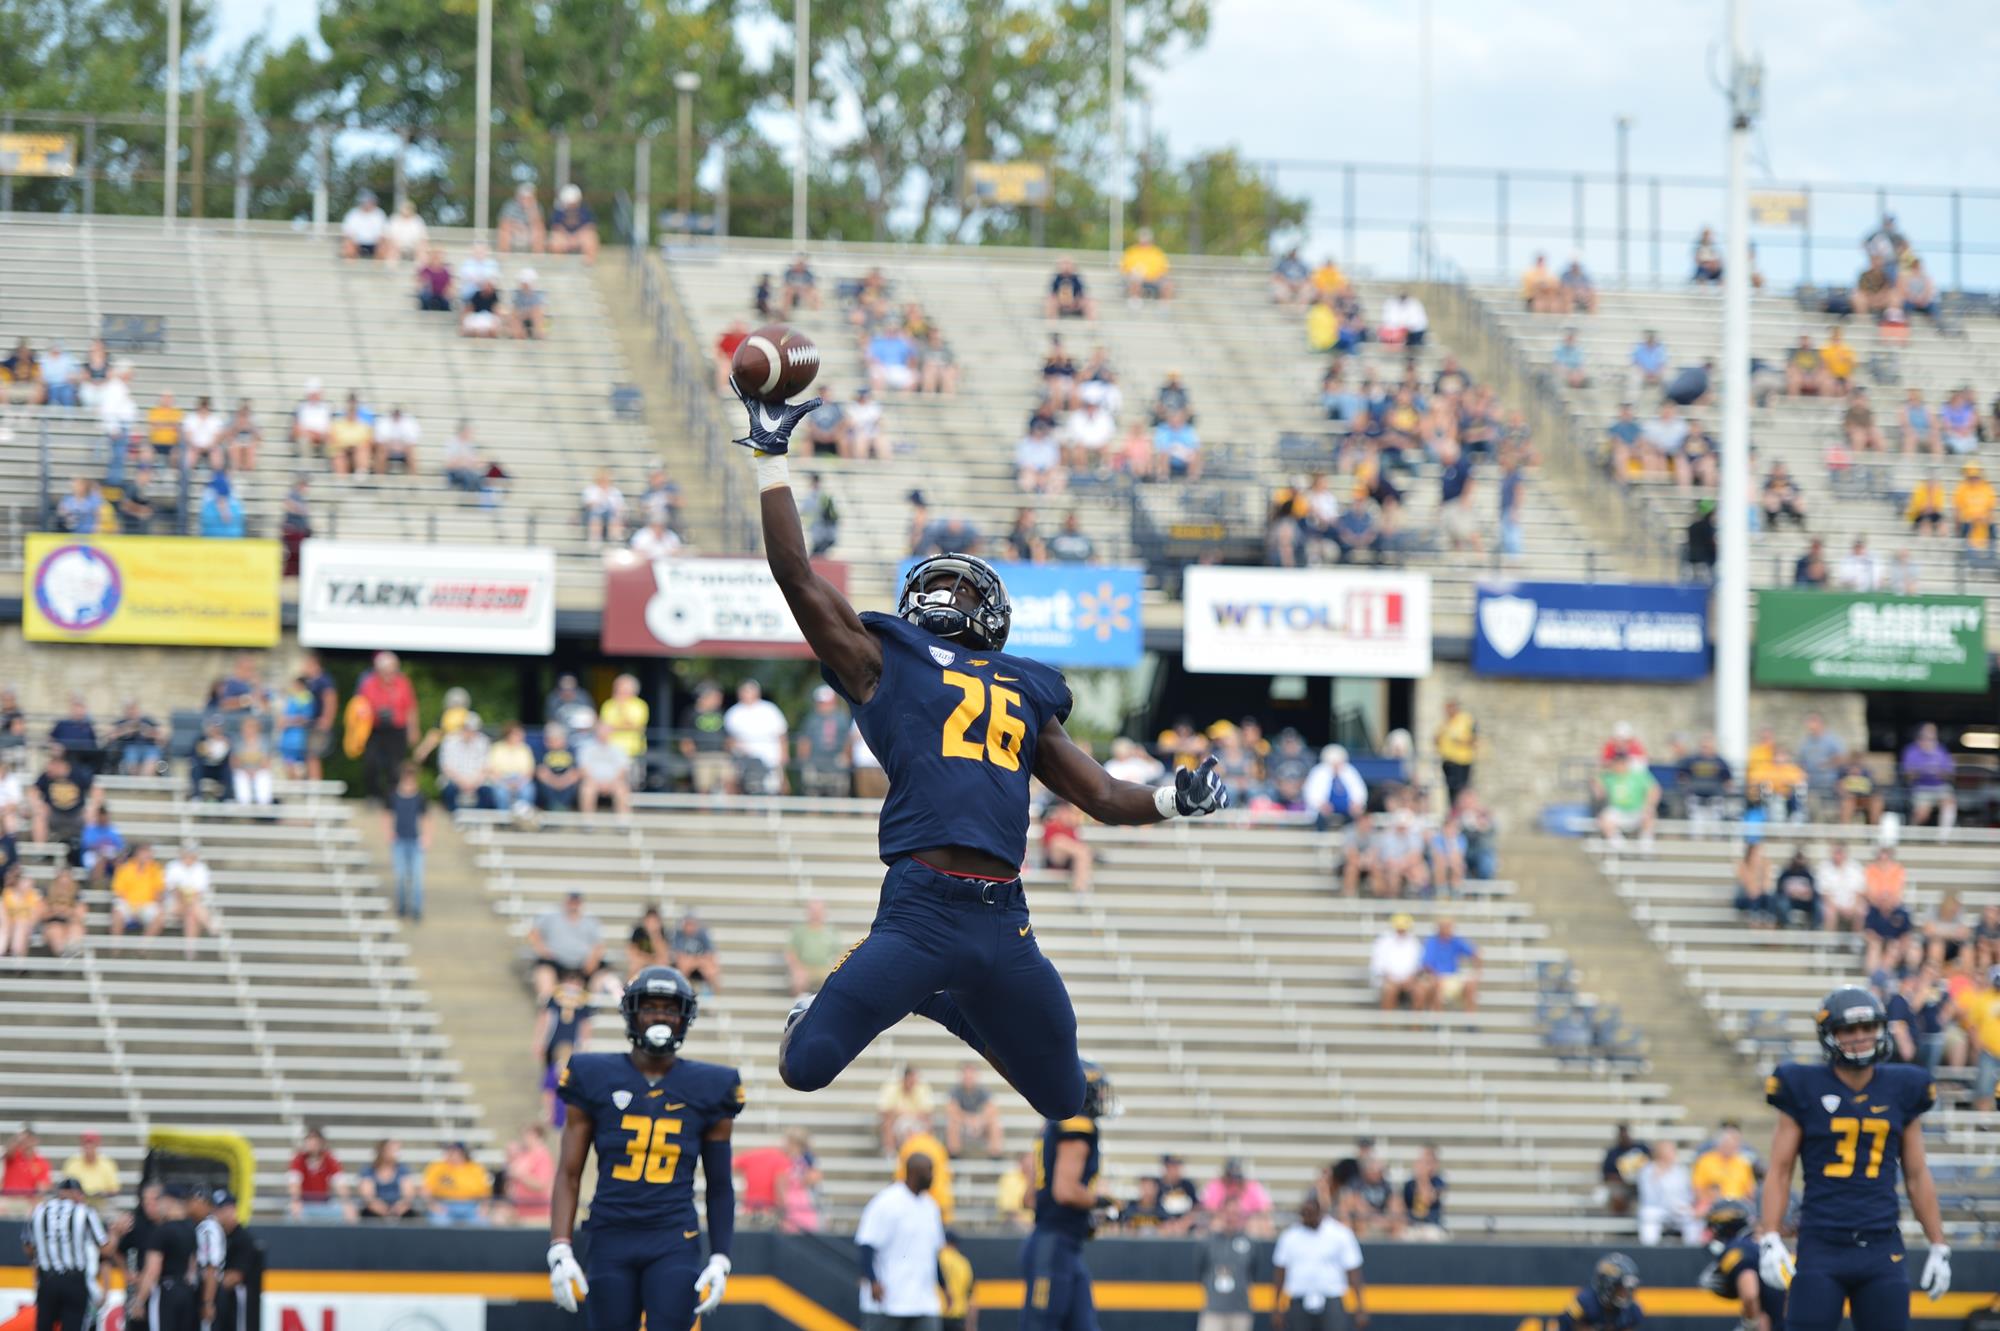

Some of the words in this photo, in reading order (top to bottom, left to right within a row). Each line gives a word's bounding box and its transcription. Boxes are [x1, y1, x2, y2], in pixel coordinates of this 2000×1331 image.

[327, 580, 423, 609] YARK
[1209, 599, 1345, 632] WTOL
[942, 669, 1026, 772] 26
[611, 1114, 683, 1184] 36
[1823, 1117, 1890, 1178] 37
